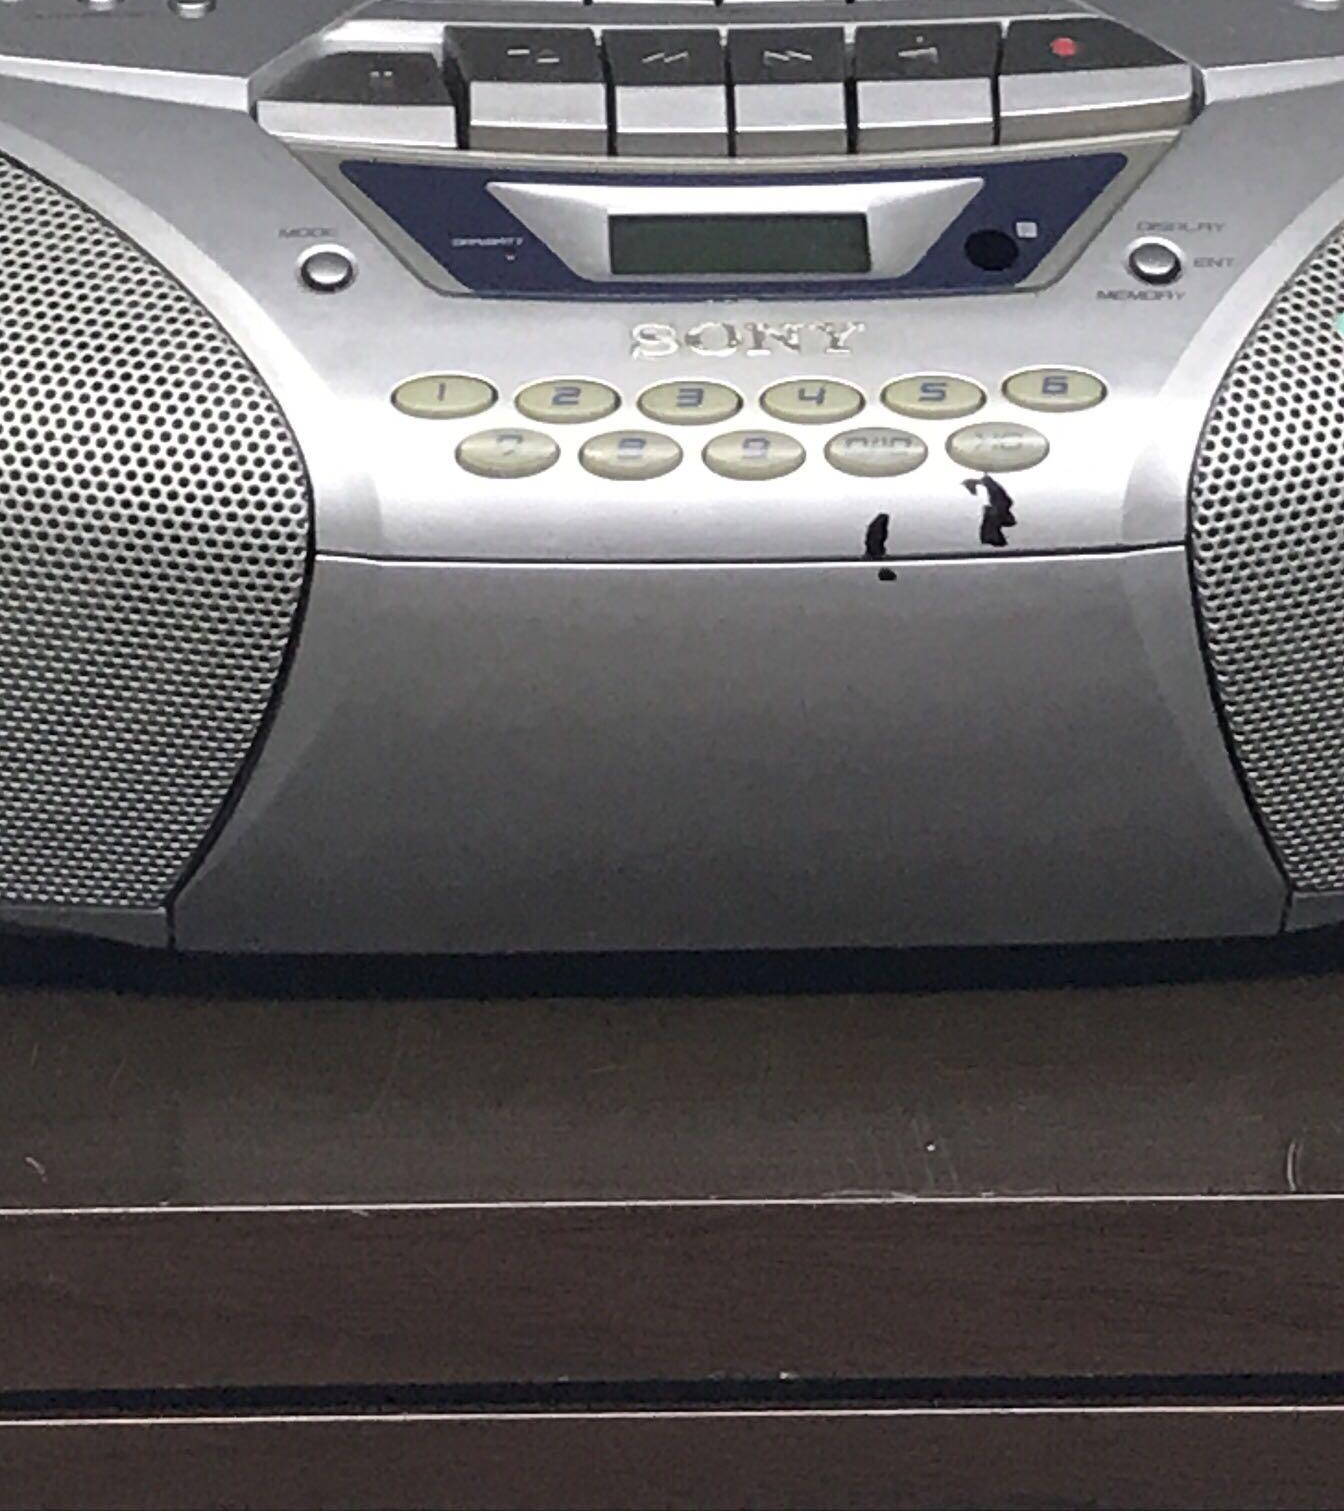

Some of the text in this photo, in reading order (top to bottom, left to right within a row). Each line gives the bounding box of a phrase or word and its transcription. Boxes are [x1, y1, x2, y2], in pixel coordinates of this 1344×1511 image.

[1136, 221, 1225, 232] DISPLAY
[1096, 290, 1186, 301] MEMORY
[630, 321, 865, 360] SONY
[437, 375, 1069, 408] 1 2 3 4 5 6
